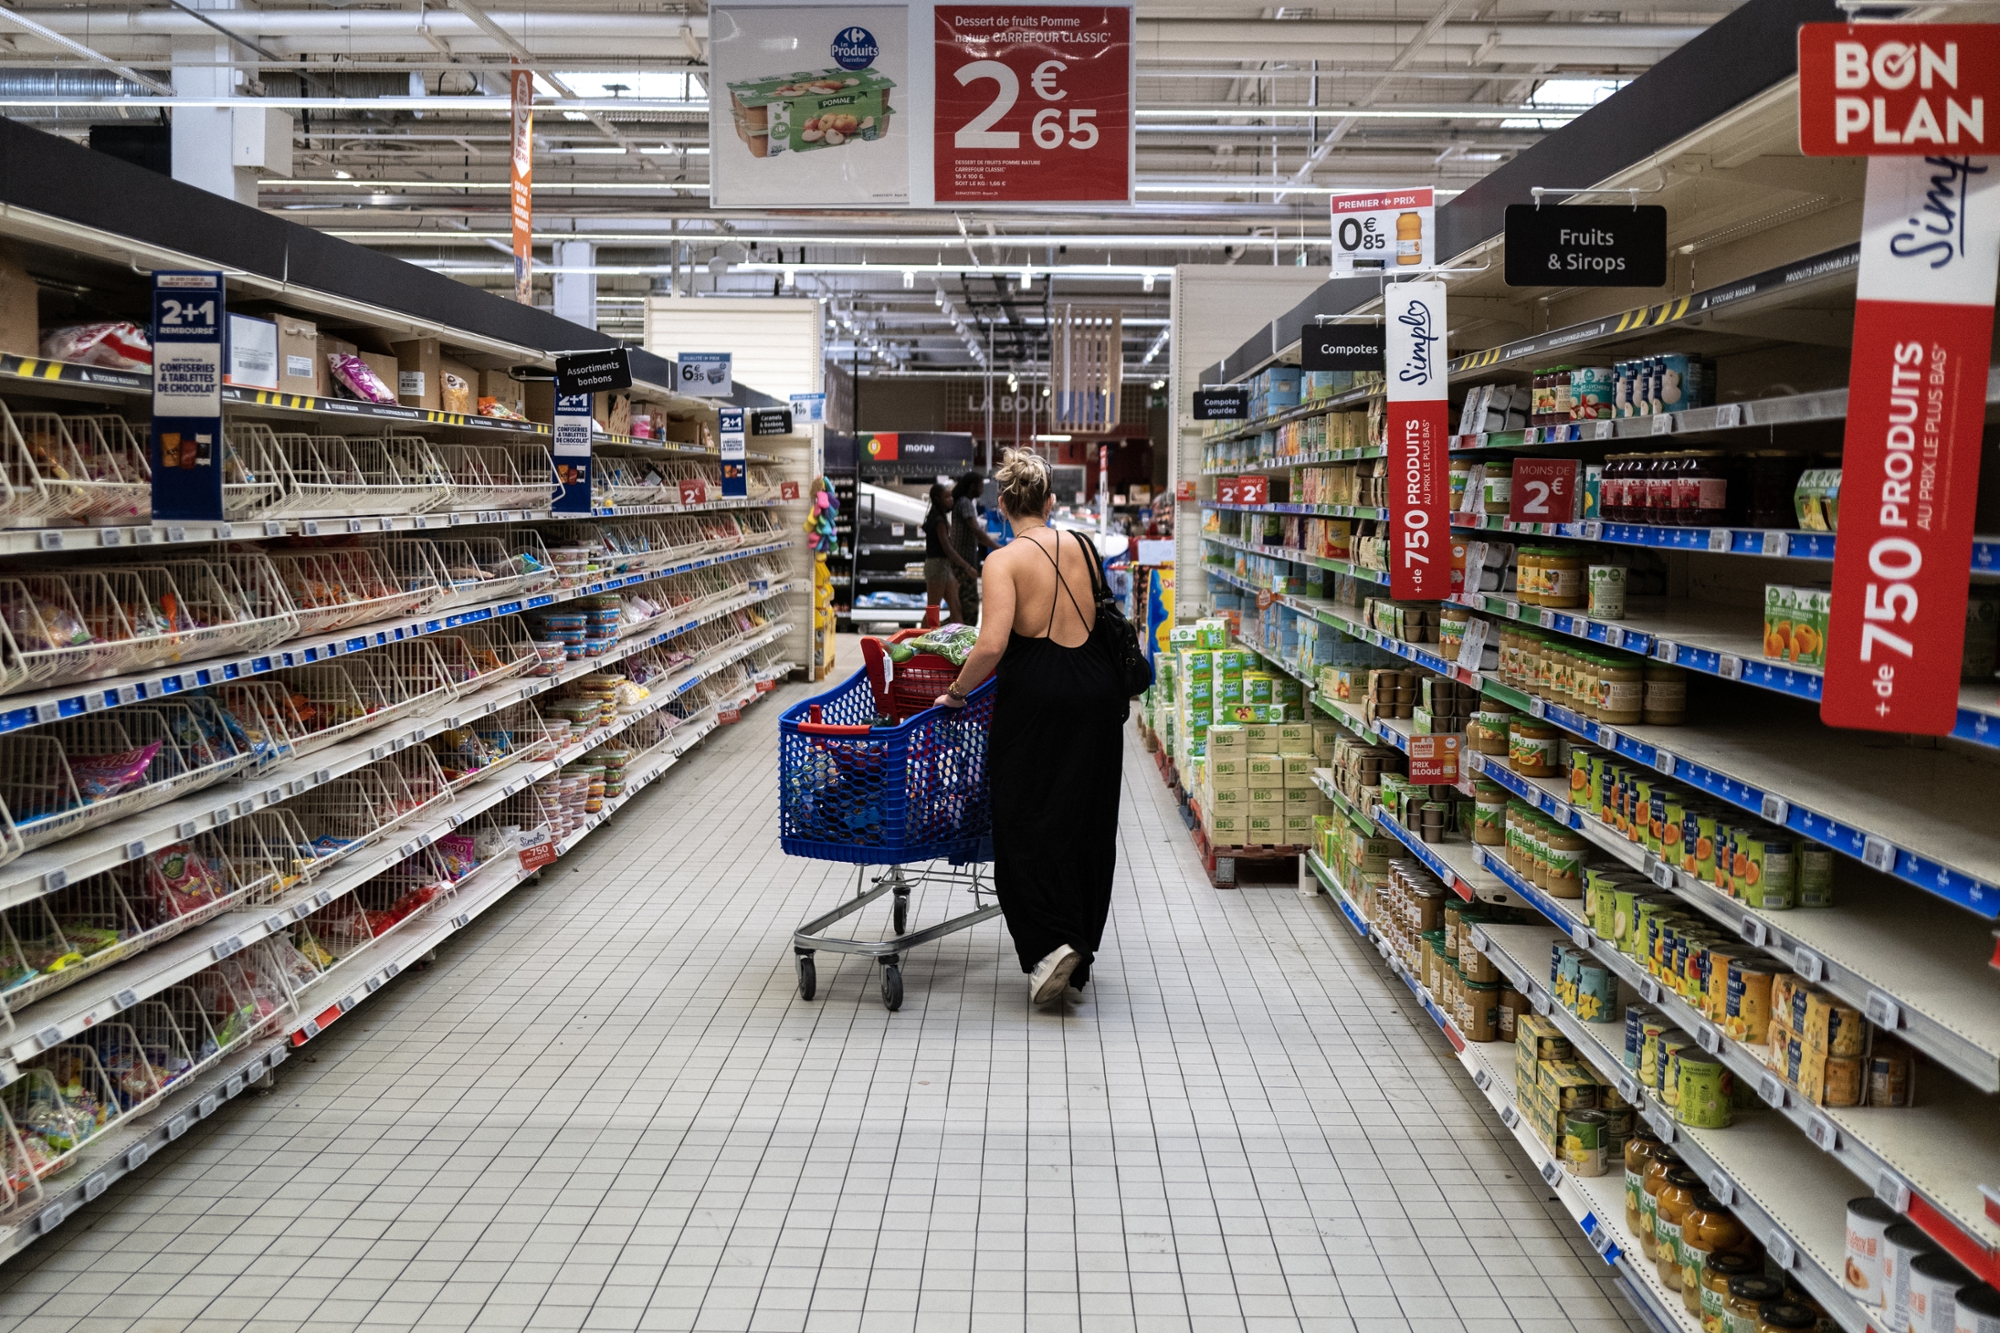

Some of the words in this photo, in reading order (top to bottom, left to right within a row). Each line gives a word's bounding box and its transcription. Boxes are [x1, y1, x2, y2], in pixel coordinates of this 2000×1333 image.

[955, 16, 994, 27] Dessert
[996, 16, 1010, 27] de
[1012, 16, 1039, 27] fruits
[1041, 16, 1080, 27] Pomme
[955, 33, 990, 43] nature
[992, 32, 1059, 43] CARREFOUR
[831, 45, 879, 56] Produits
[1834, 41, 1958, 90] BON
[822, 97, 850, 107] POMME
[1835, 96, 1984, 145] PLAN
[1338, 199, 1379, 209] PREMIER
[1394, 196, 1416, 205] PRIX
[1560, 228, 1614, 246] Fruits
[1548, 252, 1561, 271] &
[1566, 252, 1626, 274] Sirops
[1785, 267, 1812, 283] PRODUITS
[1813, 256, 1850, 275] DISPONIBLES
[1711, 290, 1735, 305] STOCKAGE
[1735, 284, 1756, 298] MAGASIN
[162, 300, 215, 325] 2+1
[1321, 343, 1378, 357] Compotes
[160, 363, 215, 373] CONFISERIES
[567, 361, 619, 376] Assortiments
[161, 373, 167, 382] &
[169, 373, 214, 382] TABLETTES
[578, 375, 612, 386] bonbons
[158, 384, 169, 392] DE
[559, 393, 588, 406] 2+1
[969, 396, 994, 412] LA
[1208, 407, 1237, 416] gourdes
[1926, 388, 1943, 433] PLUS
[722, 417, 742, 427] 2+1
[1880, 342, 1924, 528] PRODUITS
[905, 444, 935, 452] morue
[1923, 436, 1939, 458] LE
[1406, 419, 1421, 505] PRODUITS
[1423, 458, 1431, 468] LE
[1520, 466, 1553, 475] MOINS
[1556, 466, 1570, 476] DE
[1919, 461, 1936, 501] PRIX
[1424, 494, 1431, 505] AU
[1917, 505, 1932, 531] AU
[1404, 510, 1430, 568] 750
[1412, 568, 1423, 584] de
[1860, 537, 1923, 662] 750
[1872, 664, 1895, 697] de
[1876, 701, 1891, 718] +
[1248, 729, 1266, 737] BIO
[1282, 729, 1300, 737] BIO
[1216, 736, 1234, 744] BIO
[1217, 764, 1235, 772] BIO
[1252, 764, 1270, 772] BIO
[1289, 764, 1307, 772] BIO
[1412, 767, 1441, 775] BLOQUÉ
[1218, 792, 1236, 800] BIO
[1254, 792, 1272, 800] BIO
[1289, 791, 1307, 800] BIO
[1216, 820, 1234, 829] BIO
[1252, 820, 1270, 828] BIO
[1289, 820, 1307, 828] BIO
[530, 845, 549, 856] 750
[1368, 844, 1389, 854] BIO
[525, 853, 550, 864] PRODUITS
